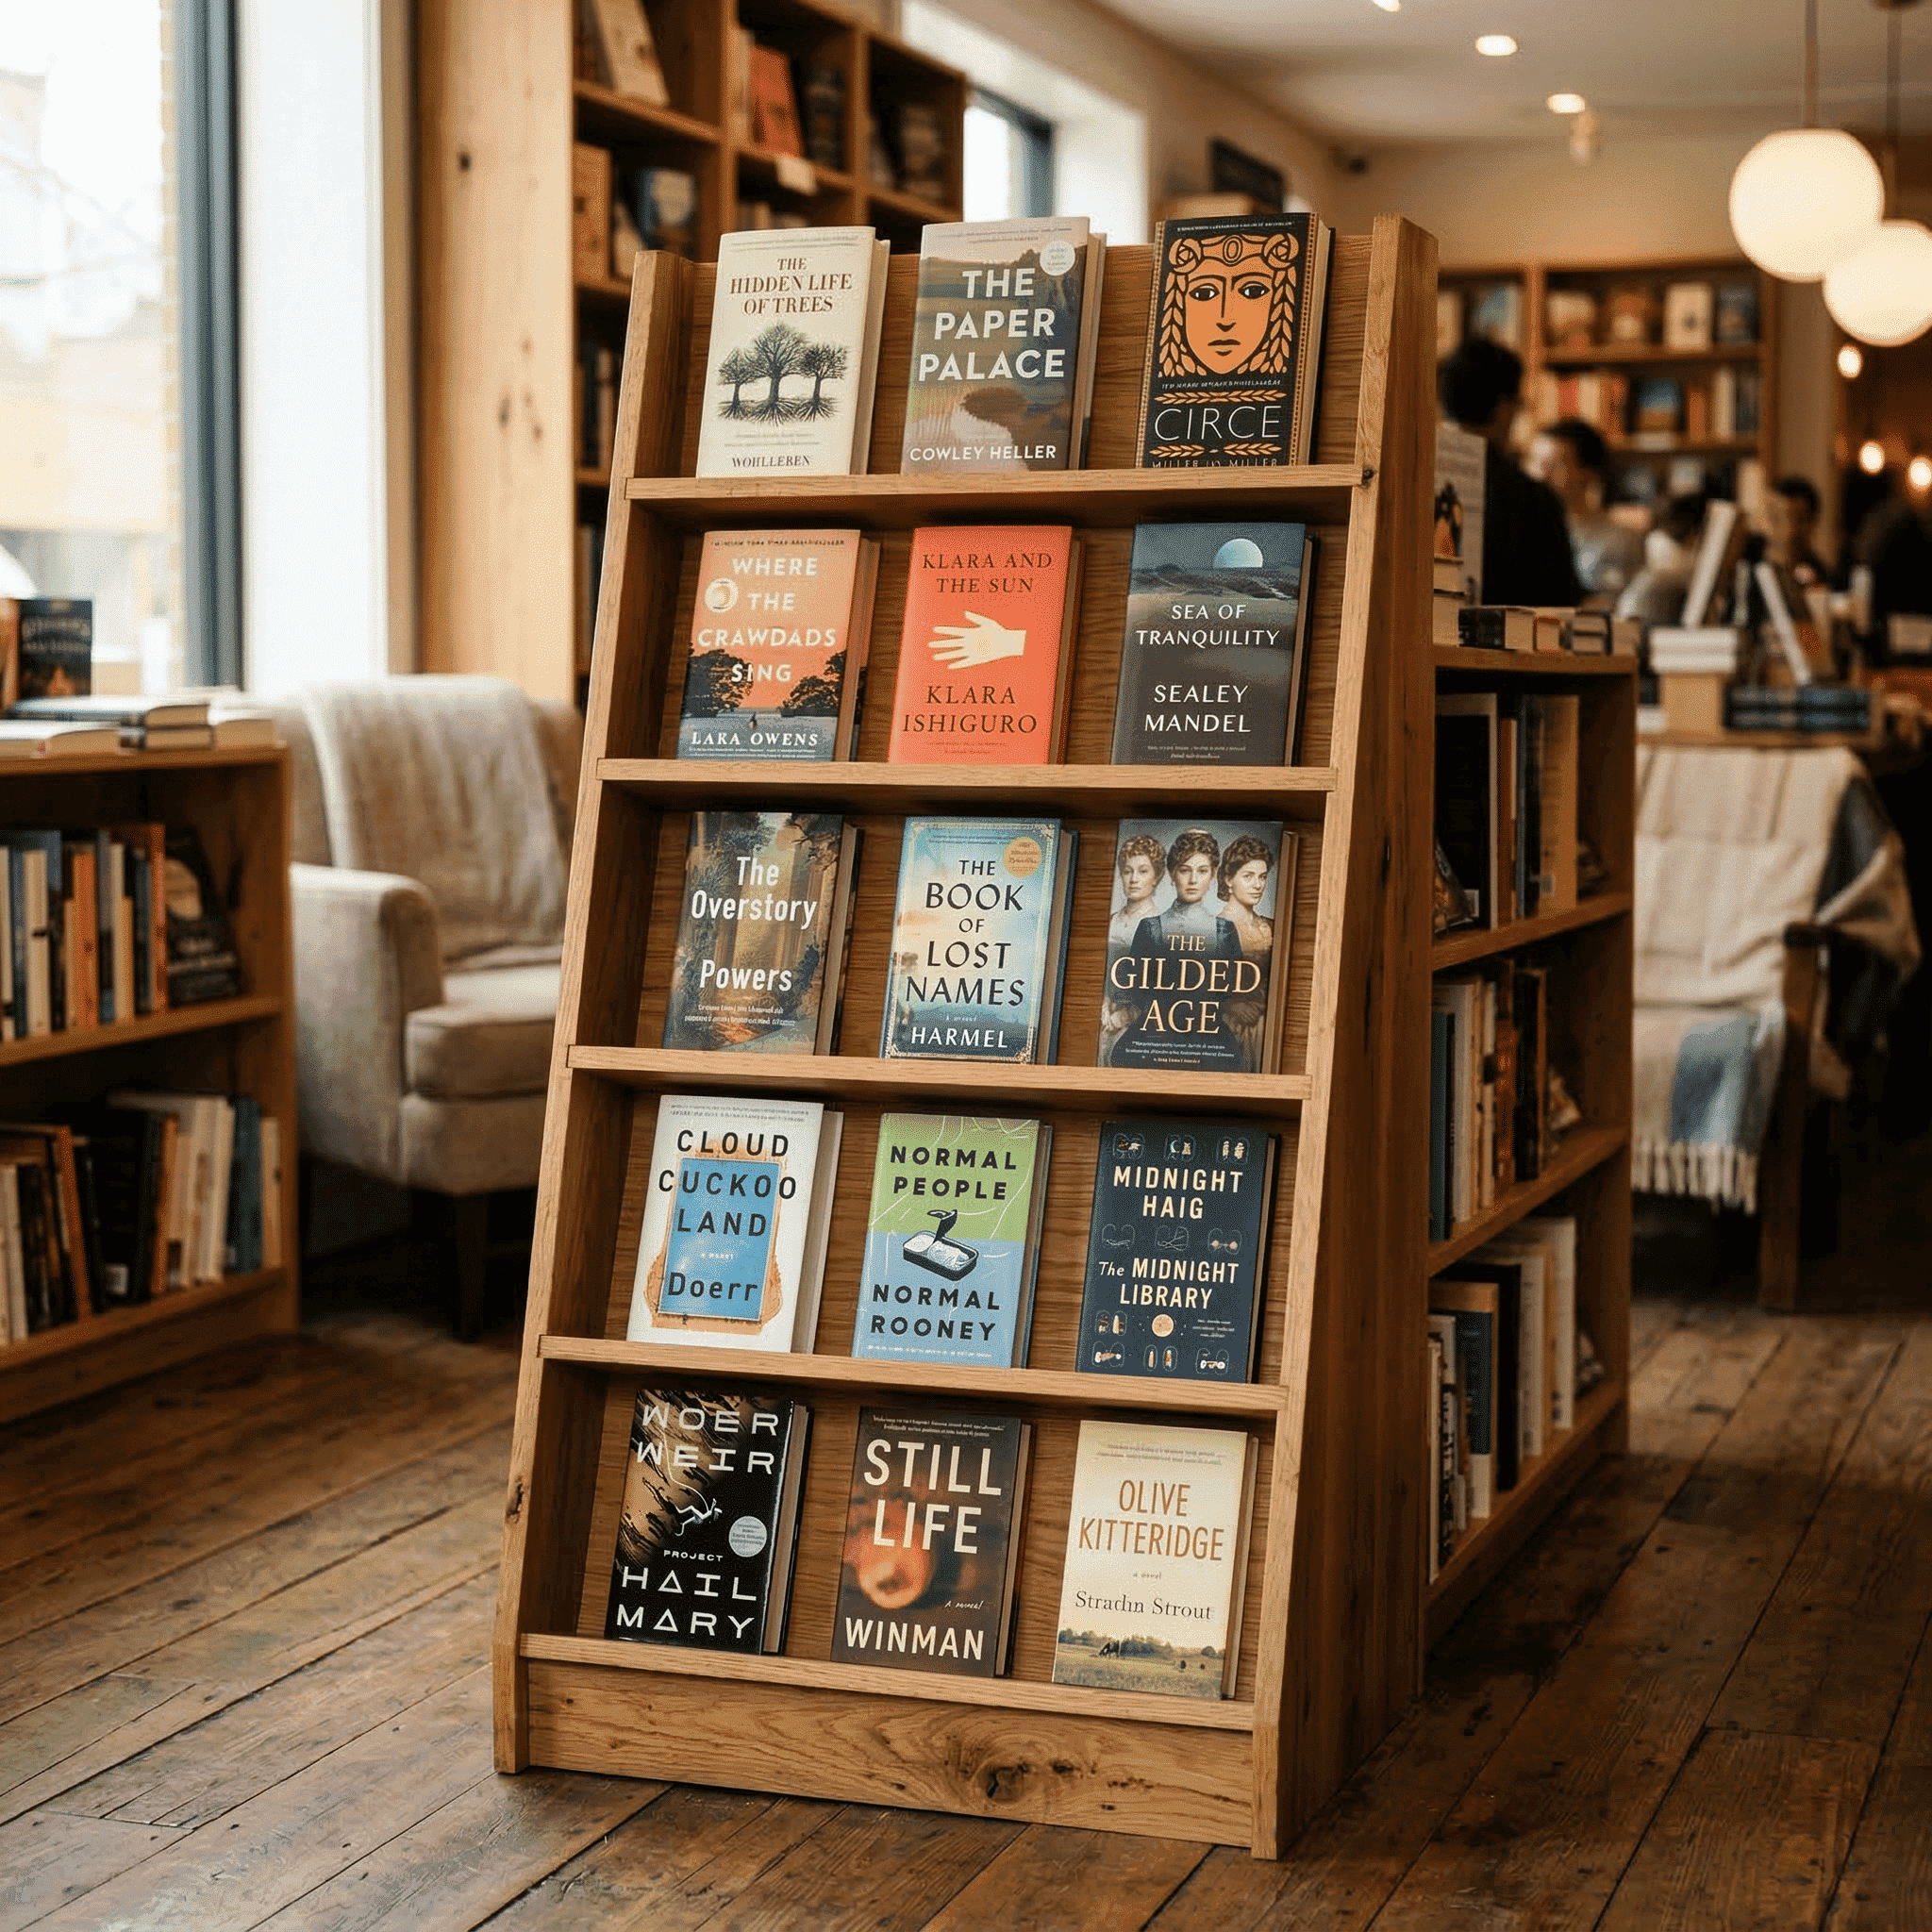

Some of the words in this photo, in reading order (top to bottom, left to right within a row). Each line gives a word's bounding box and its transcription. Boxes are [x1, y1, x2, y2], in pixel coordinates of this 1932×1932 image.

[777, 258, 808, 271] THE
[731, 275, 804, 294] HIDDEN
[808, 274, 853, 291] LIFE
[962, 268, 1036, 298] THE
[744, 299, 770, 314] OF
[773, 296, 833, 313] TREES
[934, 308, 1056, 340] PAPER
[918, 349, 1066, 381] PALACE
[1154, 406, 1283, 441] CIRCE
[909, 446, 985, 461] COWLEY
[990, 445, 1057, 459] HELLER
[731, 558, 818, 576] WHERE
[922, 554, 996, 569] KLARA
[1004, 553, 1053, 569] AND
[936, 578, 980, 593] THE
[988, 577, 1034, 593] SUN
[747, 592, 796, 611] THE
[1171, 604, 1208, 620] SEA
[1218, 604, 1247, 620] OF
[697, 628, 837, 647] CRAWDADS
[1136, 630, 1280, 649] TRANQUILITY
[731, 663, 792, 682] SING
[925, 686, 1016, 705] KLARA
[1153, 685, 1249, 703] SEALEY
[902, 714, 1038, 734] ISHIGURO
[1144, 714, 1251, 732] MANDEL
[691, 732, 741, 745] LARA
[750, 732, 819, 746] OWENS
[736, 856, 779, 886] The
[958, 859, 996, 876] THE
[924, 882, 1024, 911] BOOK
[691, 890, 817, 930] Overstory
[958, 918, 986, 934] OF
[927, 941, 1011, 969] LOST
[1167, 935, 1207, 952] THE
[699, 959, 792, 991] Powers
[1110, 957, 1261, 993] GILDED
[906, 975, 1025, 1007] NAMES
[1140, 999, 1220, 1034] AGE
[911, 1026, 1008, 1048] HARMEL
[676, 1129, 789, 1158] CLOUD
[890, 1145, 1017, 1170] NORMAL
[658, 1169, 796, 1200] CUCKOO
[893, 1176, 1007, 1200] PEOPLE
[1113, 1165, 1243, 1193] MIDNIGHT
[1142, 1195, 1204, 1220] HAIG
[676, 1208, 767, 1237] LAND
[1098, 1261, 1125, 1276] The
[1132, 1257, 1240, 1284] MIDNIGHT
[667, 1272, 758, 1302] Doerr
[873, 1284, 1000, 1310] NORMAL
[1120, 1284, 1212, 1309] LIBRARY
[870, 1315, 996, 1341] ROONEY
[637, 1441, 775, 1474] WEIR
[863, 1439, 1002, 1496] STILL
[1119, 1479, 1191, 1517] OLIVE
[874, 1499, 982, 1555] LIFE
[1078, 1517, 1224, 1561] KITTERIDGE
[663, 1550, 724, 1562] PROJECT
[622, 1566, 757, 1602] HAIL
[616, 1604, 755, 1639] MARY
[1152, 1597, 1211, 1620] Strout
[845, 1617, 984, 1661] WINMAN
